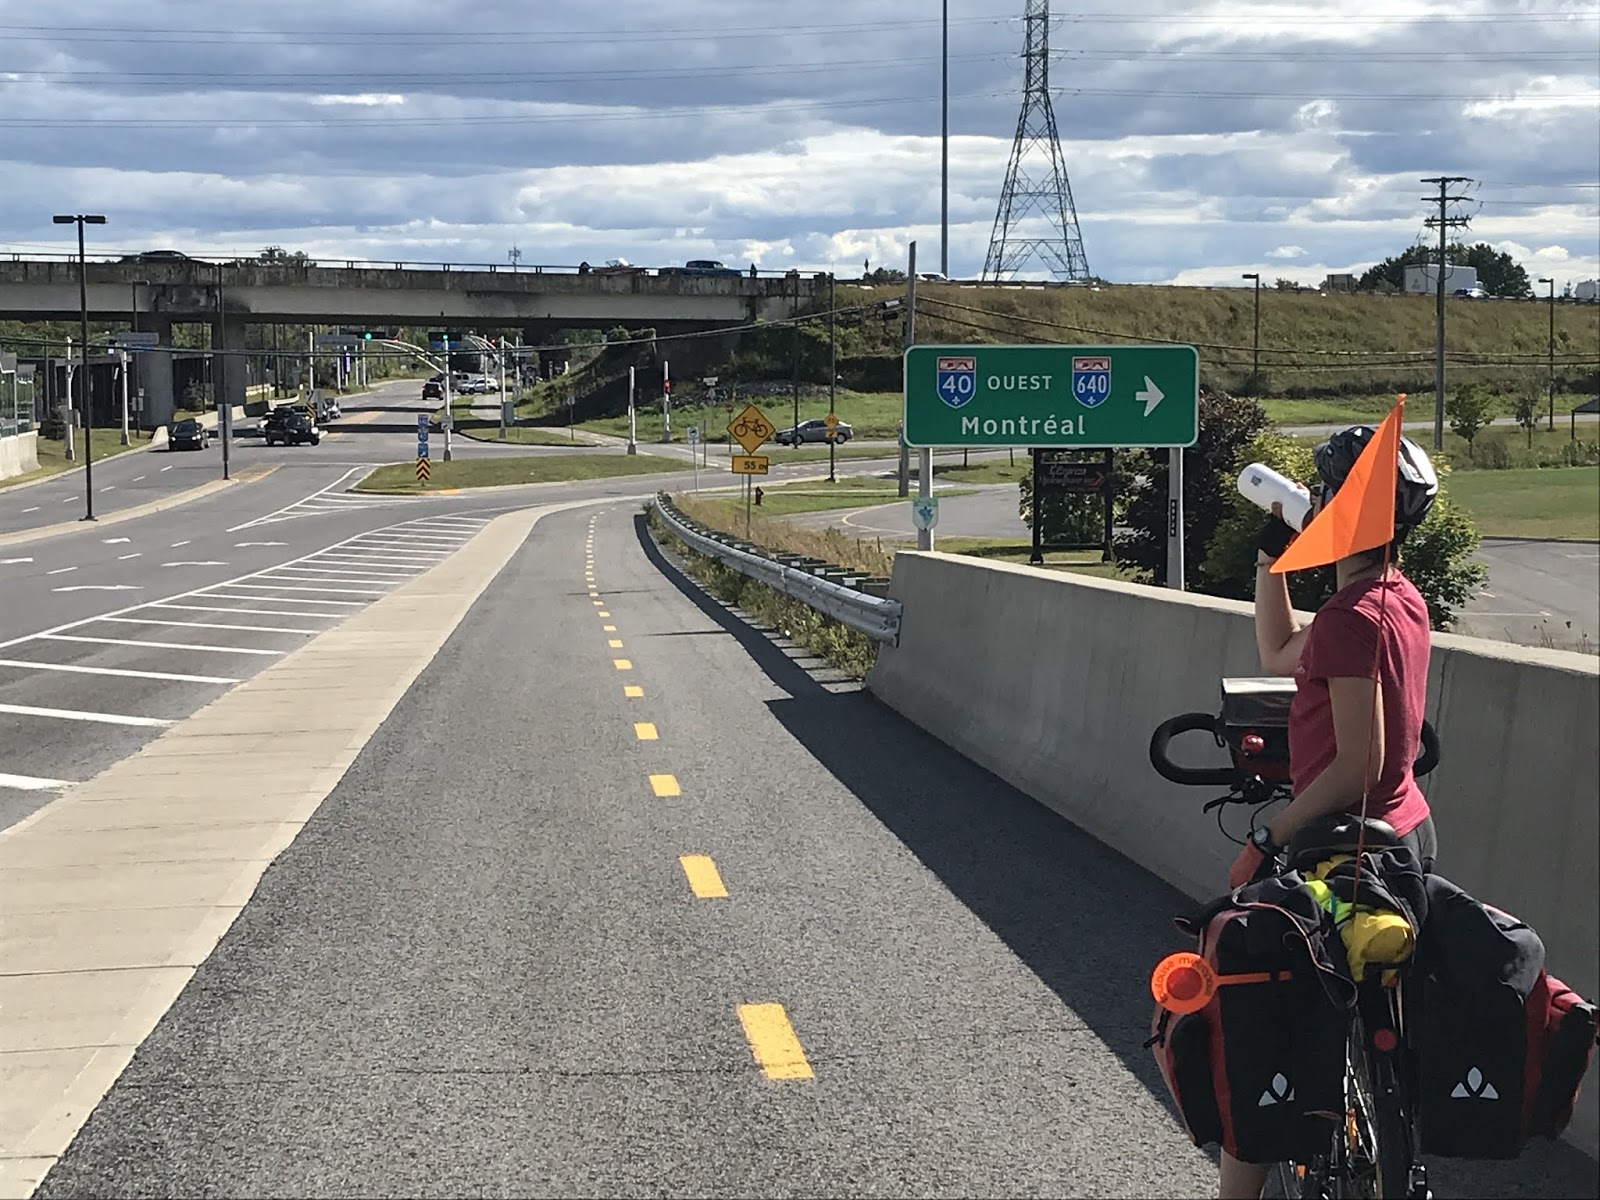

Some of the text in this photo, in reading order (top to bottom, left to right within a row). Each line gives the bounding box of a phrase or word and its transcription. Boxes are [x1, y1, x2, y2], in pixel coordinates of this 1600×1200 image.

[942, 374, 1107, 394] 40 OUEST 640
[961, 415, 1086, 435] Montréal
[744, 460, 756, 470] 55
